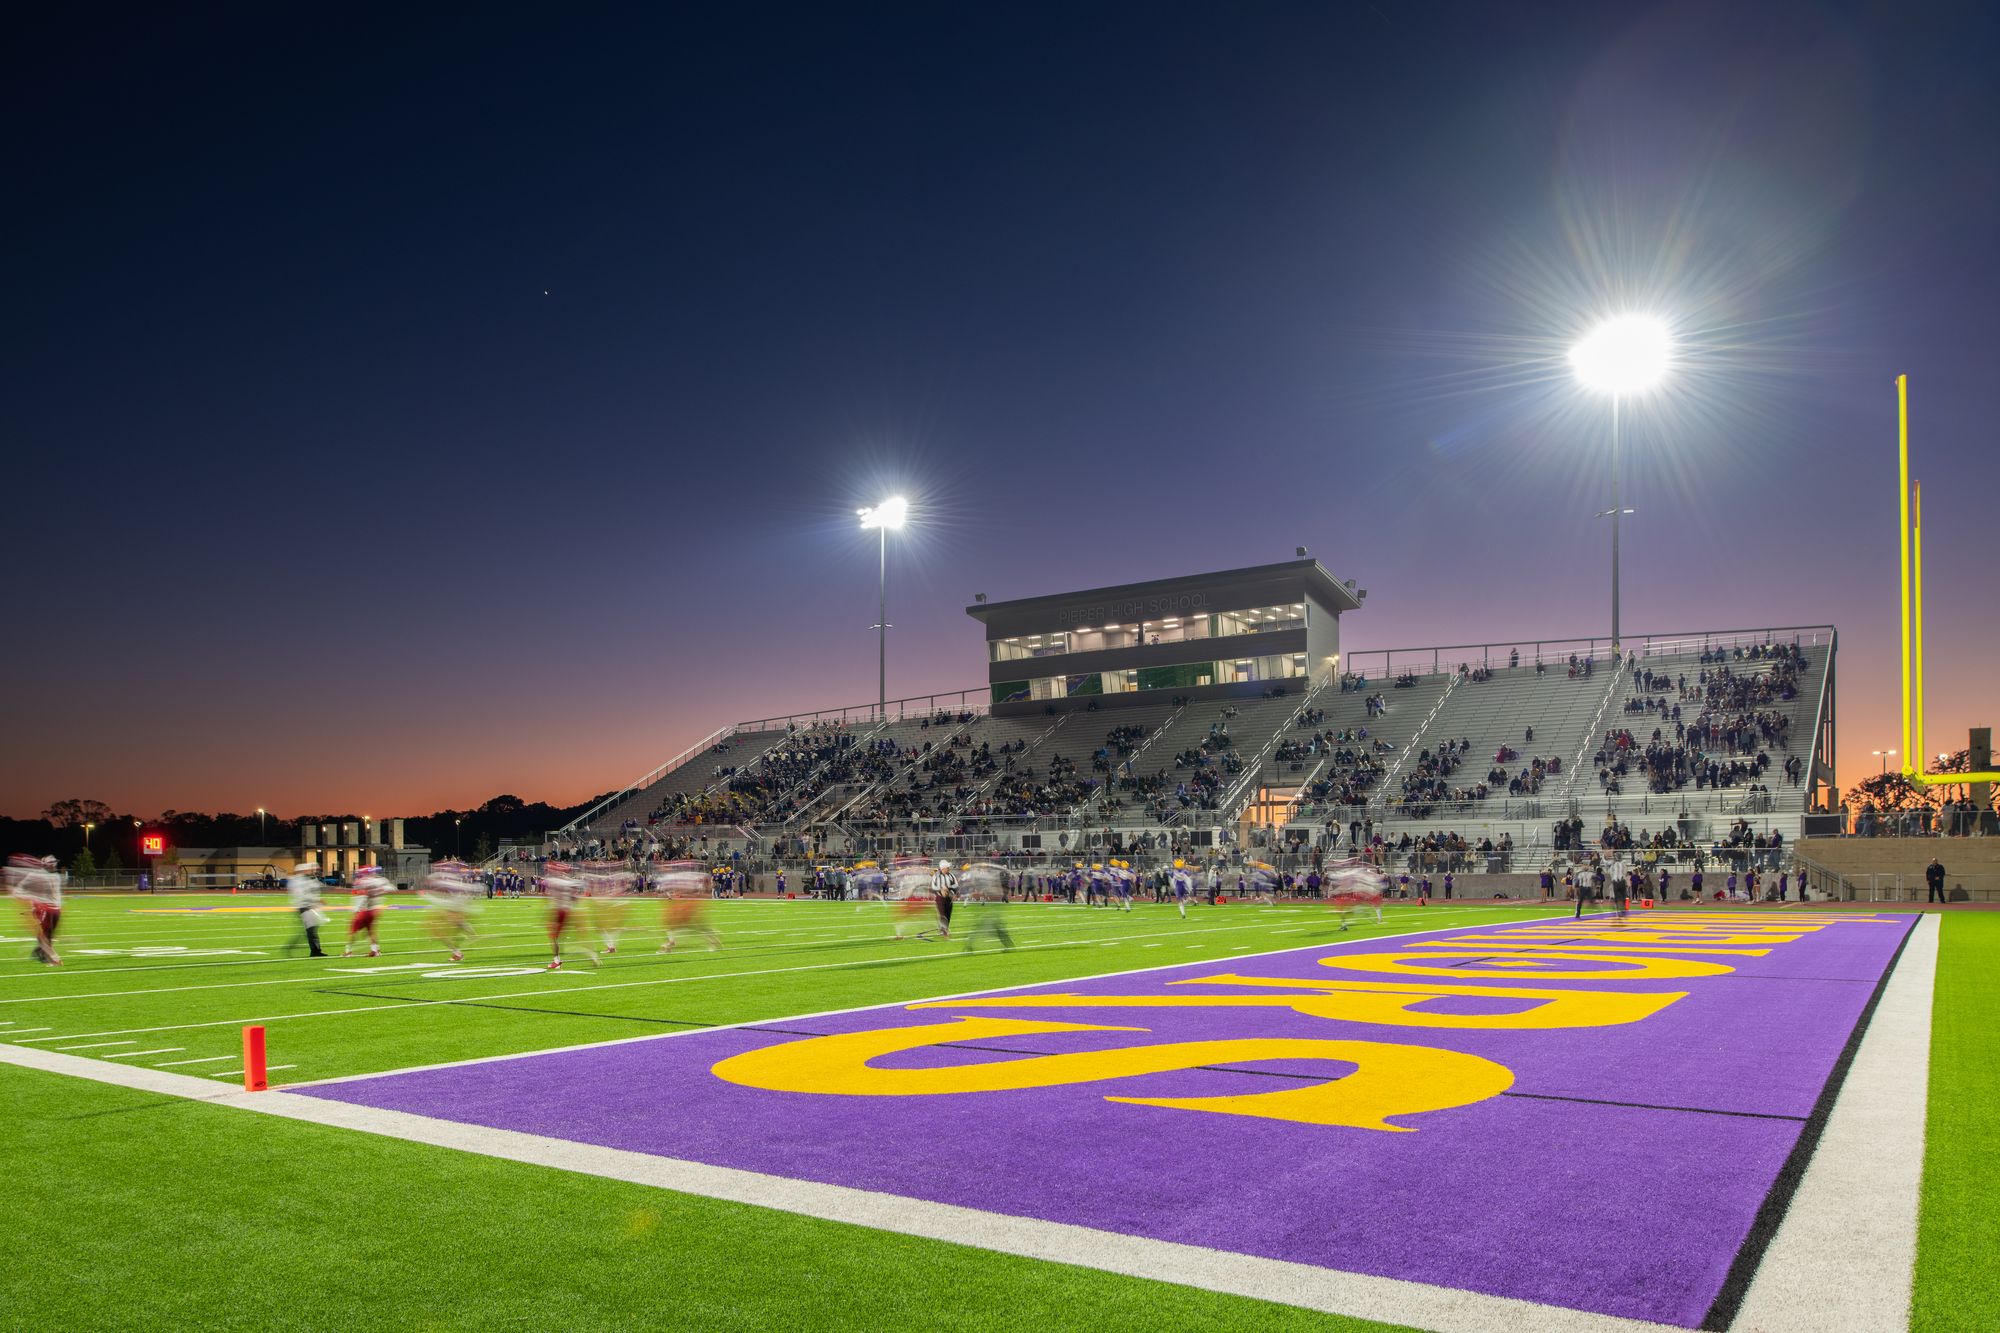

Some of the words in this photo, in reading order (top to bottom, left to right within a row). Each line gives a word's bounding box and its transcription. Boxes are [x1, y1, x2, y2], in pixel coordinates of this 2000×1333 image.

[1059, 607, 1104, 624] PIEPER
[1111, 601, 1144, 617] HIGH
[1150, 594, 1210, 613] SCHOOL
[144, 838, 160, 849] 40
